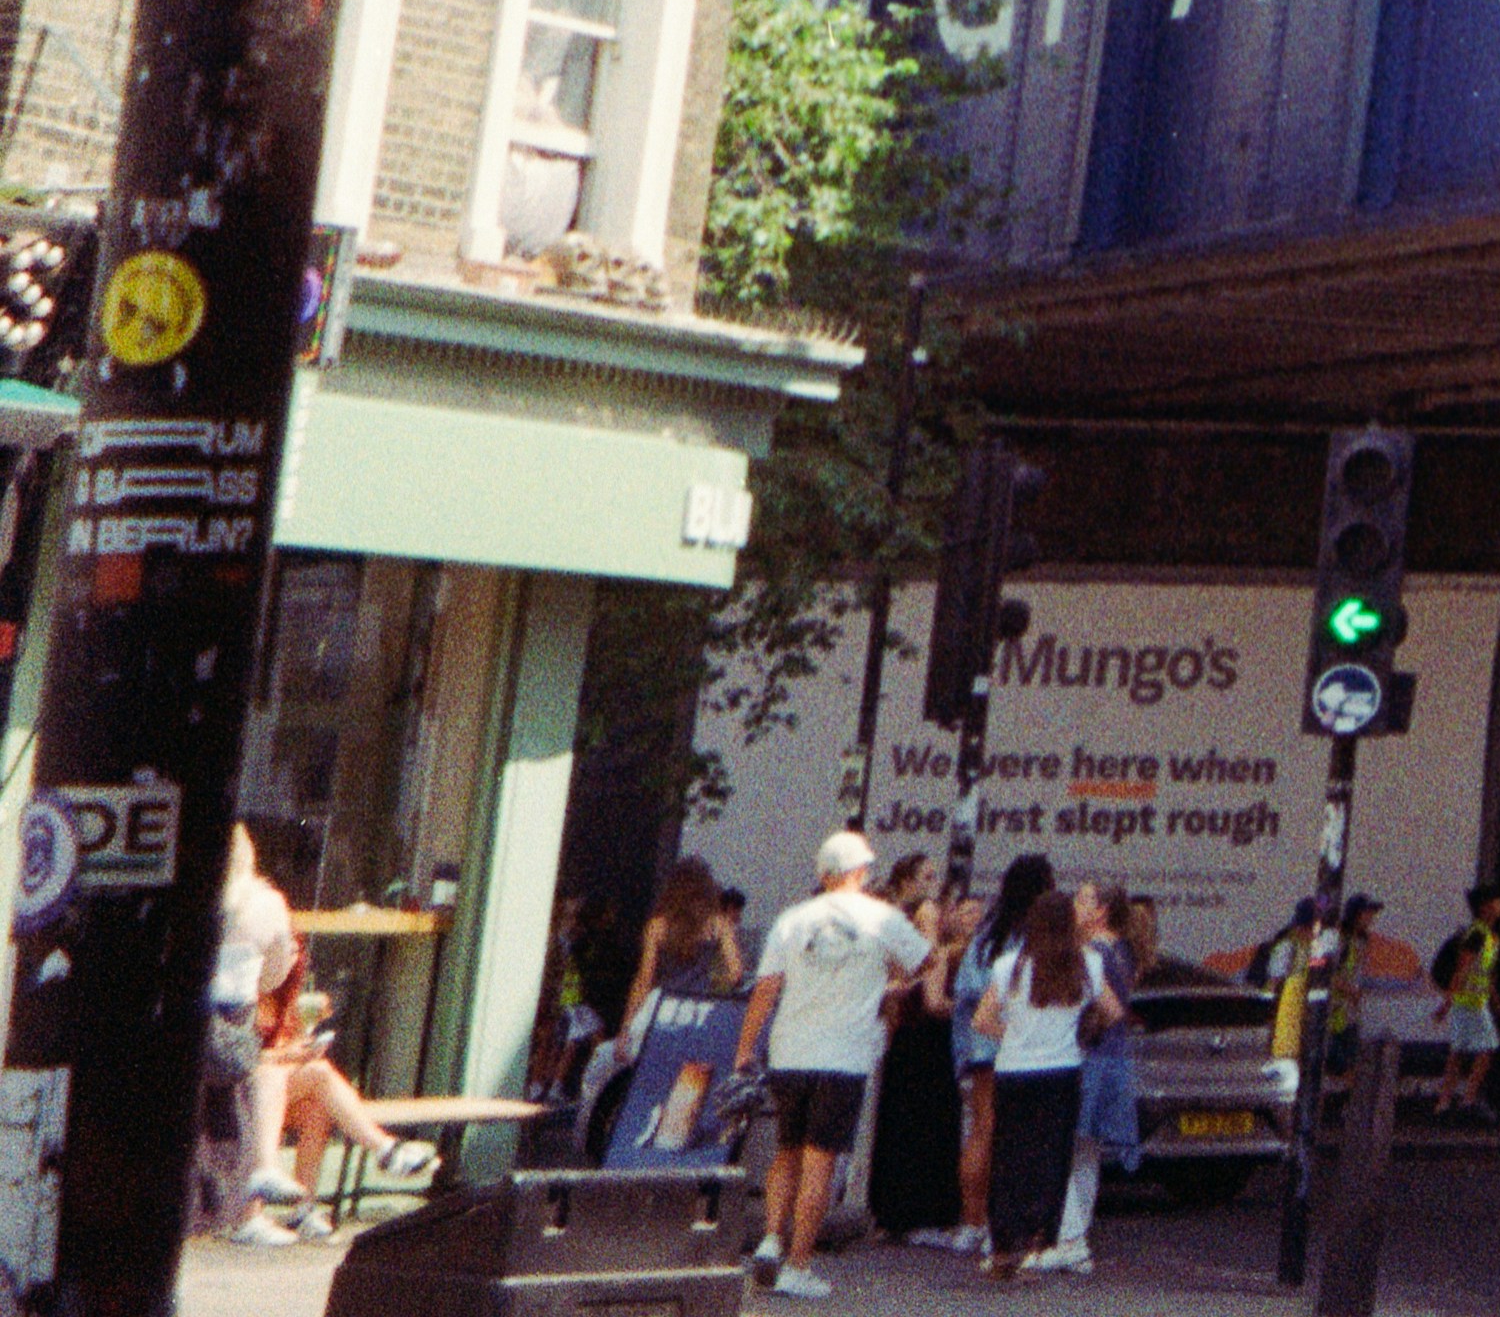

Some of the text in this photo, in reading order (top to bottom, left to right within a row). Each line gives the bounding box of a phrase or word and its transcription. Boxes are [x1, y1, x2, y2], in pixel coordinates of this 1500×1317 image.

[998, 633, 1240, 705] Mungo's
[892, 744, 954, 780] We
[1070, 745, 1158, 780] here
[1168, 747, 1277, 784] when
[876, 797, 1280, 847] Joe irst slept rough
